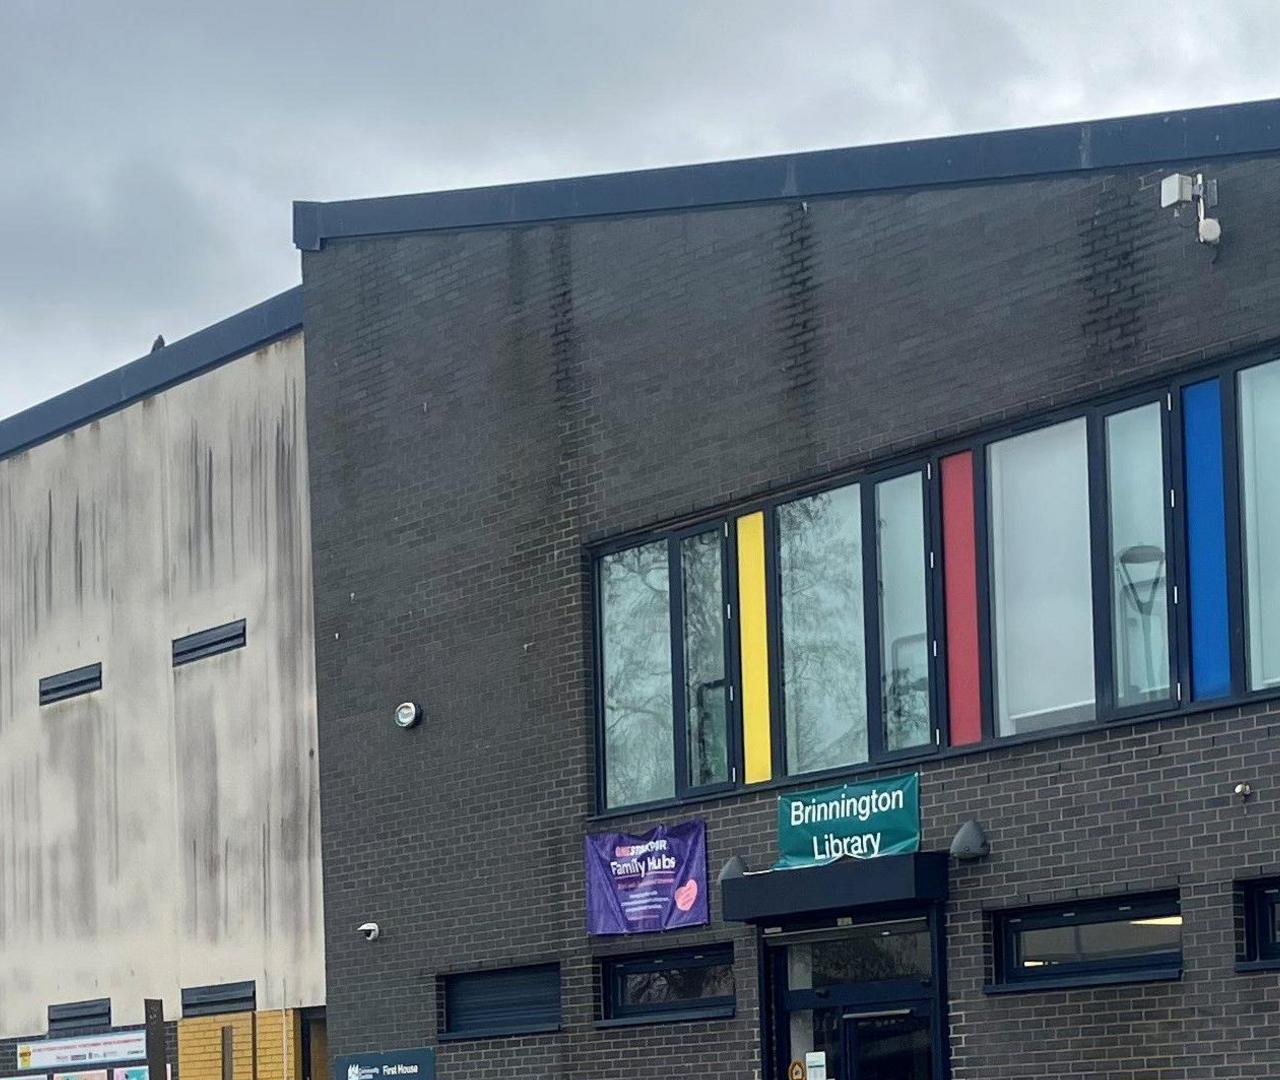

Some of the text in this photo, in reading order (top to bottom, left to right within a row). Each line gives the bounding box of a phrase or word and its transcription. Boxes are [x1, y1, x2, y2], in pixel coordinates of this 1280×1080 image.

[790, 789, 903, 826] Brinnington
[812, 832, 881, 860] Library
[610, 854, 676, 878] Family Hubs
[398, 1064, 418, 1074] House
